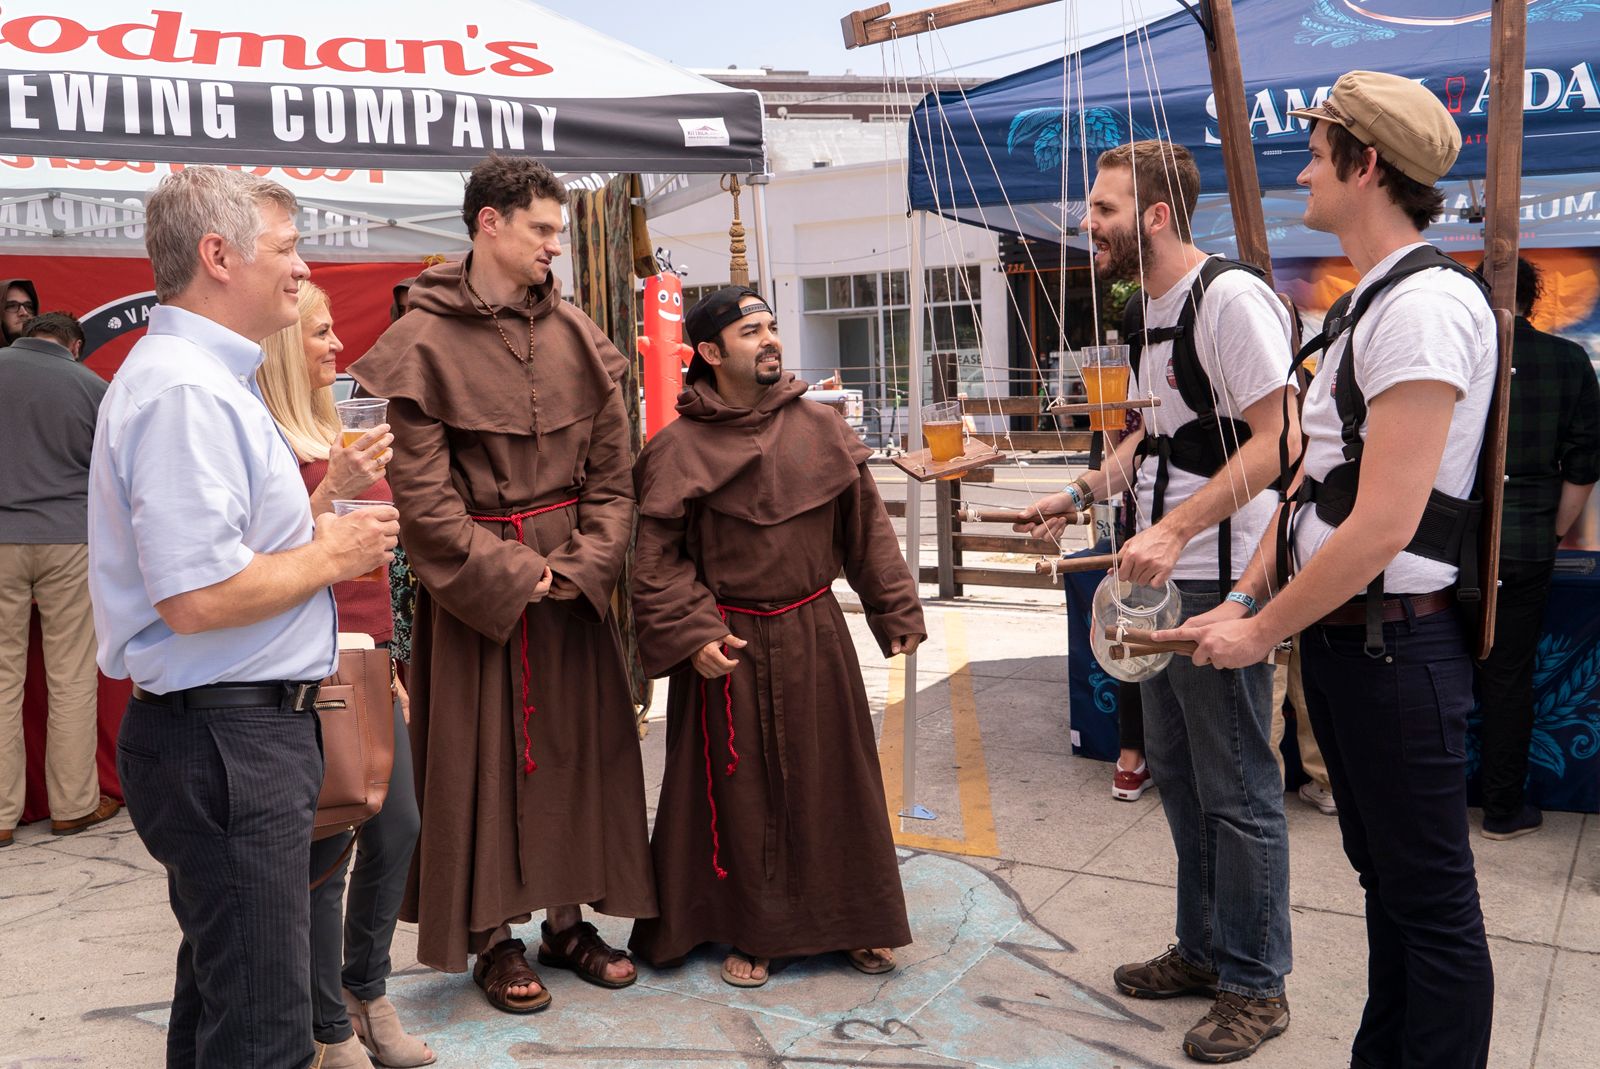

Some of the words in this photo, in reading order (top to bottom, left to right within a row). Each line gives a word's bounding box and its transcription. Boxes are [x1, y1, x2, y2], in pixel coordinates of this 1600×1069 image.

[0, 9, 554, 77] odman's
[7, 72, 237, 140] EWING
[270, 84, 558, 152] COMPANY
[957, 353, 982, 366] EASE
